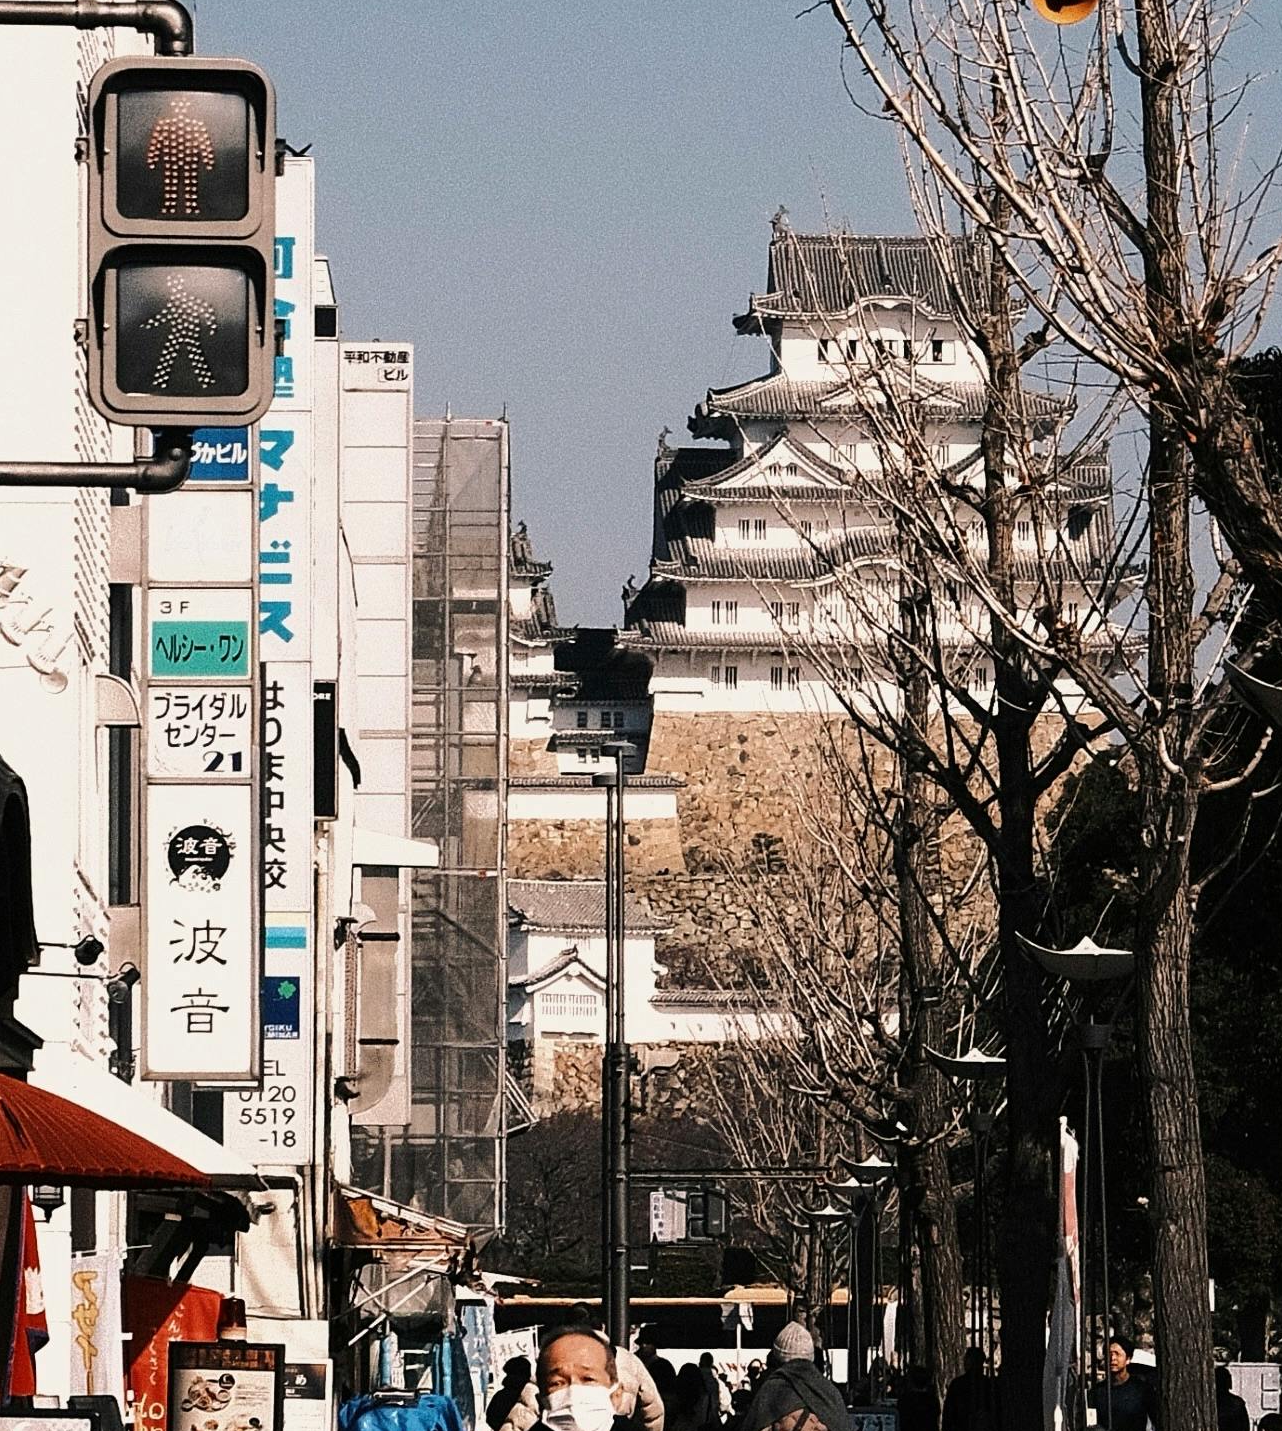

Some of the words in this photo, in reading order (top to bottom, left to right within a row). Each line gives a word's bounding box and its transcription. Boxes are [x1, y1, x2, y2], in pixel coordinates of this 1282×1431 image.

[344, 350, 410, 365] 平和不動産
[383, 368, 409, 381] ビル
[154, 692, 247, 720] ブライダル
[164, 723, 236, 748] センター
[203, 751, 243, 772] 21
[175, 837, 222, 855] 波音
[169, 919, 230, 1034] 波音
[263, 1060, 286, 1076] EL
[239, 1108, 295, 1125] 5519
[259, 1130, 296, 1147] -18
